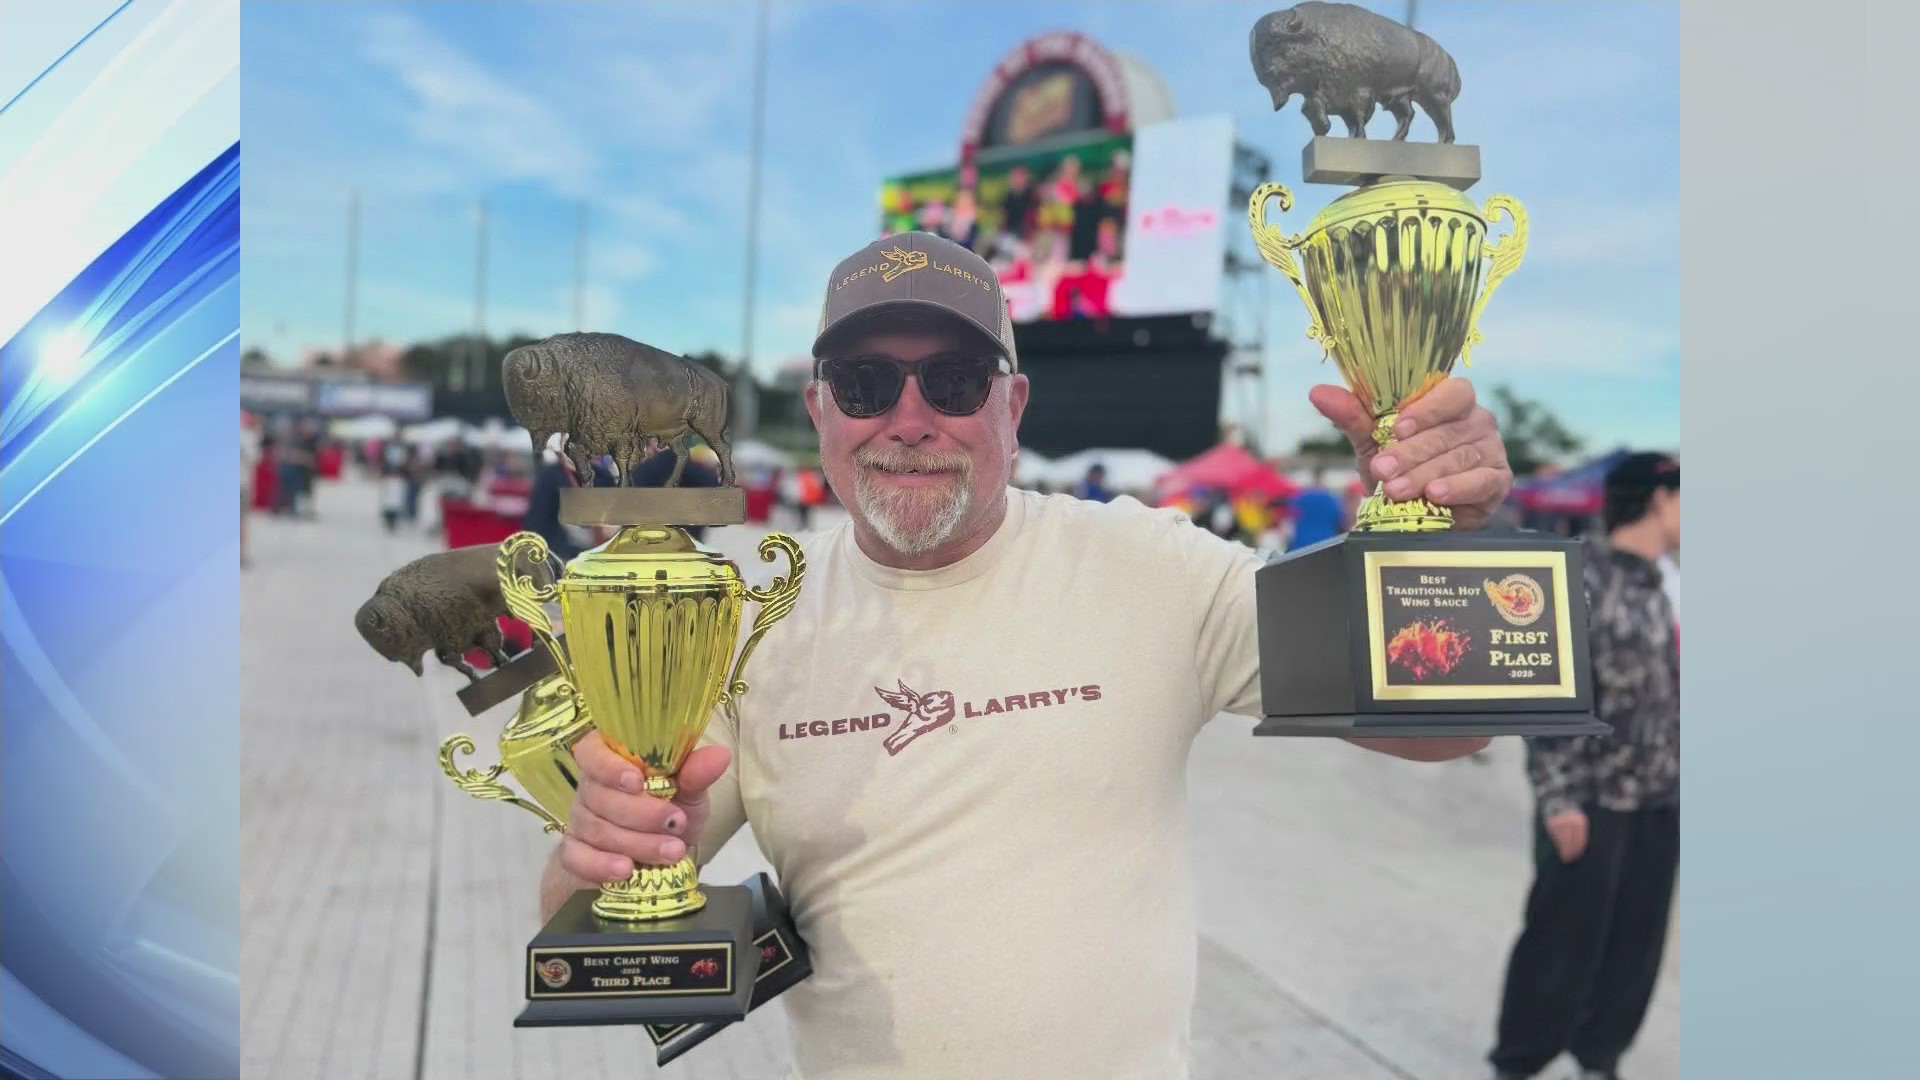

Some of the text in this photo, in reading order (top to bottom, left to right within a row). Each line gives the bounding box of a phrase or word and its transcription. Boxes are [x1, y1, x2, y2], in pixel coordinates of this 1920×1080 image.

[836, 261, 991, 291] LEGEND LARRY'S
[779, 684, 1102, 740] LEGEND LARRY'S
